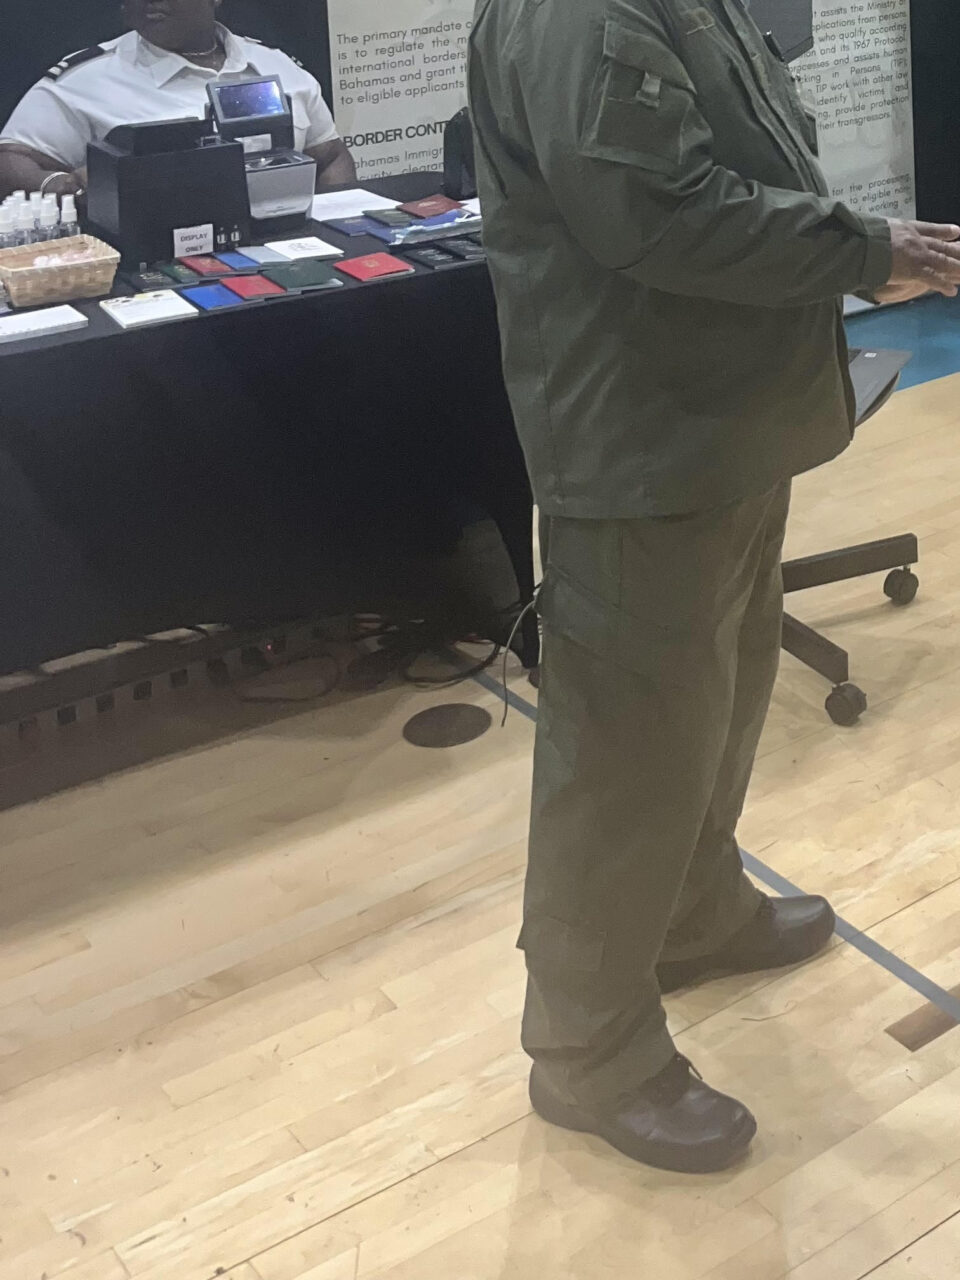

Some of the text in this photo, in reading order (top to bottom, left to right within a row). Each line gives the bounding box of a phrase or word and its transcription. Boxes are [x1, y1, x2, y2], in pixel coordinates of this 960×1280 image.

[850, 3, 864, 13] the
[336, 33, 359, 45] The
[363, 30, 407, 45] primary
[411, 21, 462, 36] mandate
[338, 51, 348, 60] is
[355, 49, 368, 58] to
[375, 41, 425, 57] regulate
[432, 37, 450, 48] the
[819, 46, 836, 56] and
[339, 50, 467, 75] international borders
[833, 57, 850, 66] and
[339, 76, 396, 91] Bahamas
[399, 69, 422, 82] and
[426, 66, 456, 81] grant
[341, 95, 354, 105] to
[357, 88, 402, 105] eligible
[343, 120, 450, 148] BORDER CONT
[354, 147, 444, 170] ahamas Immigr
